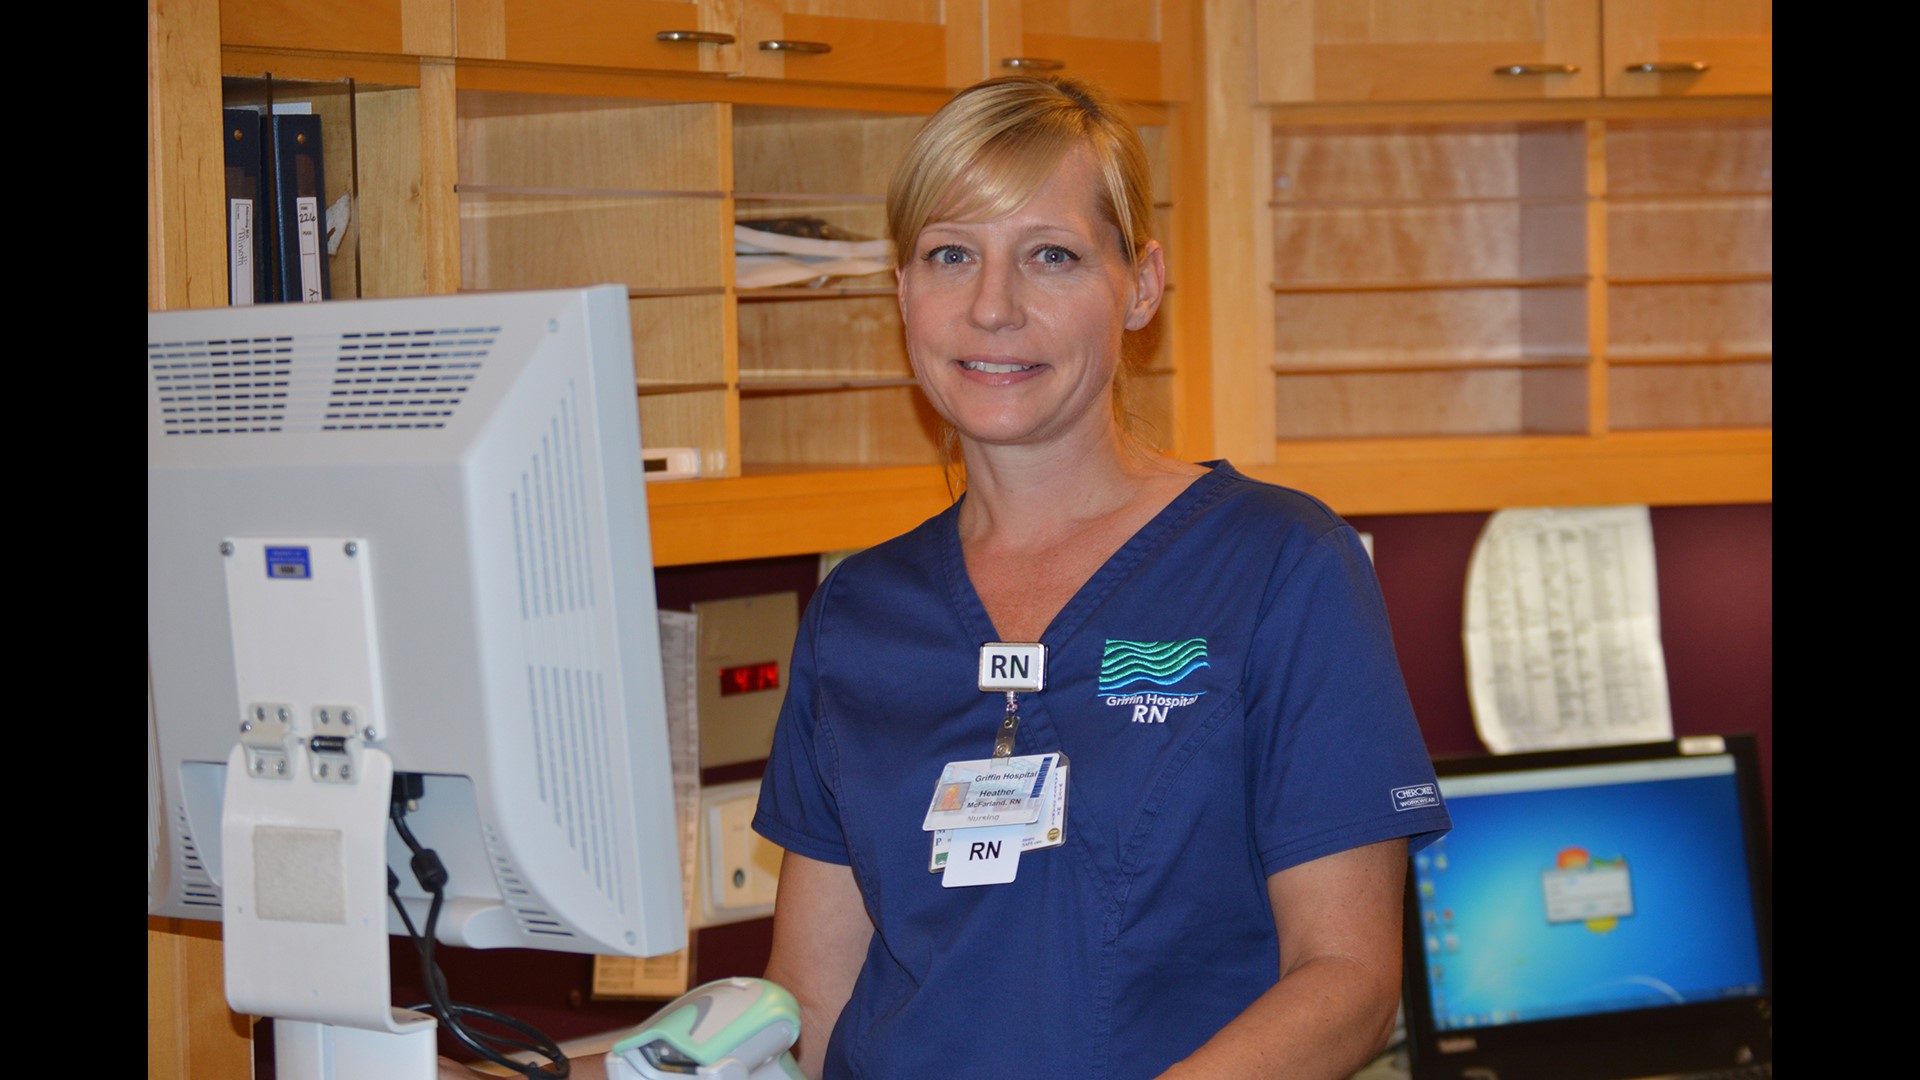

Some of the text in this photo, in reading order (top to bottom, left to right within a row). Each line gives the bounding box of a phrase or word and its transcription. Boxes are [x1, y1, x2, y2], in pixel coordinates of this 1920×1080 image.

[299, 212, 316, 224] 226
[991, 654, 1029, 679] RN
[1106, 694, 1198, 709] Griffin Hospital
[1132, 705, 1168, 723] RN
[975, 770, 1038, 783] Griffin Hospital
[979, 788, 1016, 798] Heather
[1396, 786, 1434, 799] CHEROKEE
[1399, 797, 1436, 807] WORKWEAR
[967, 814, 1000, 823] Nursing
[969, 840, 1002, 861] RN
